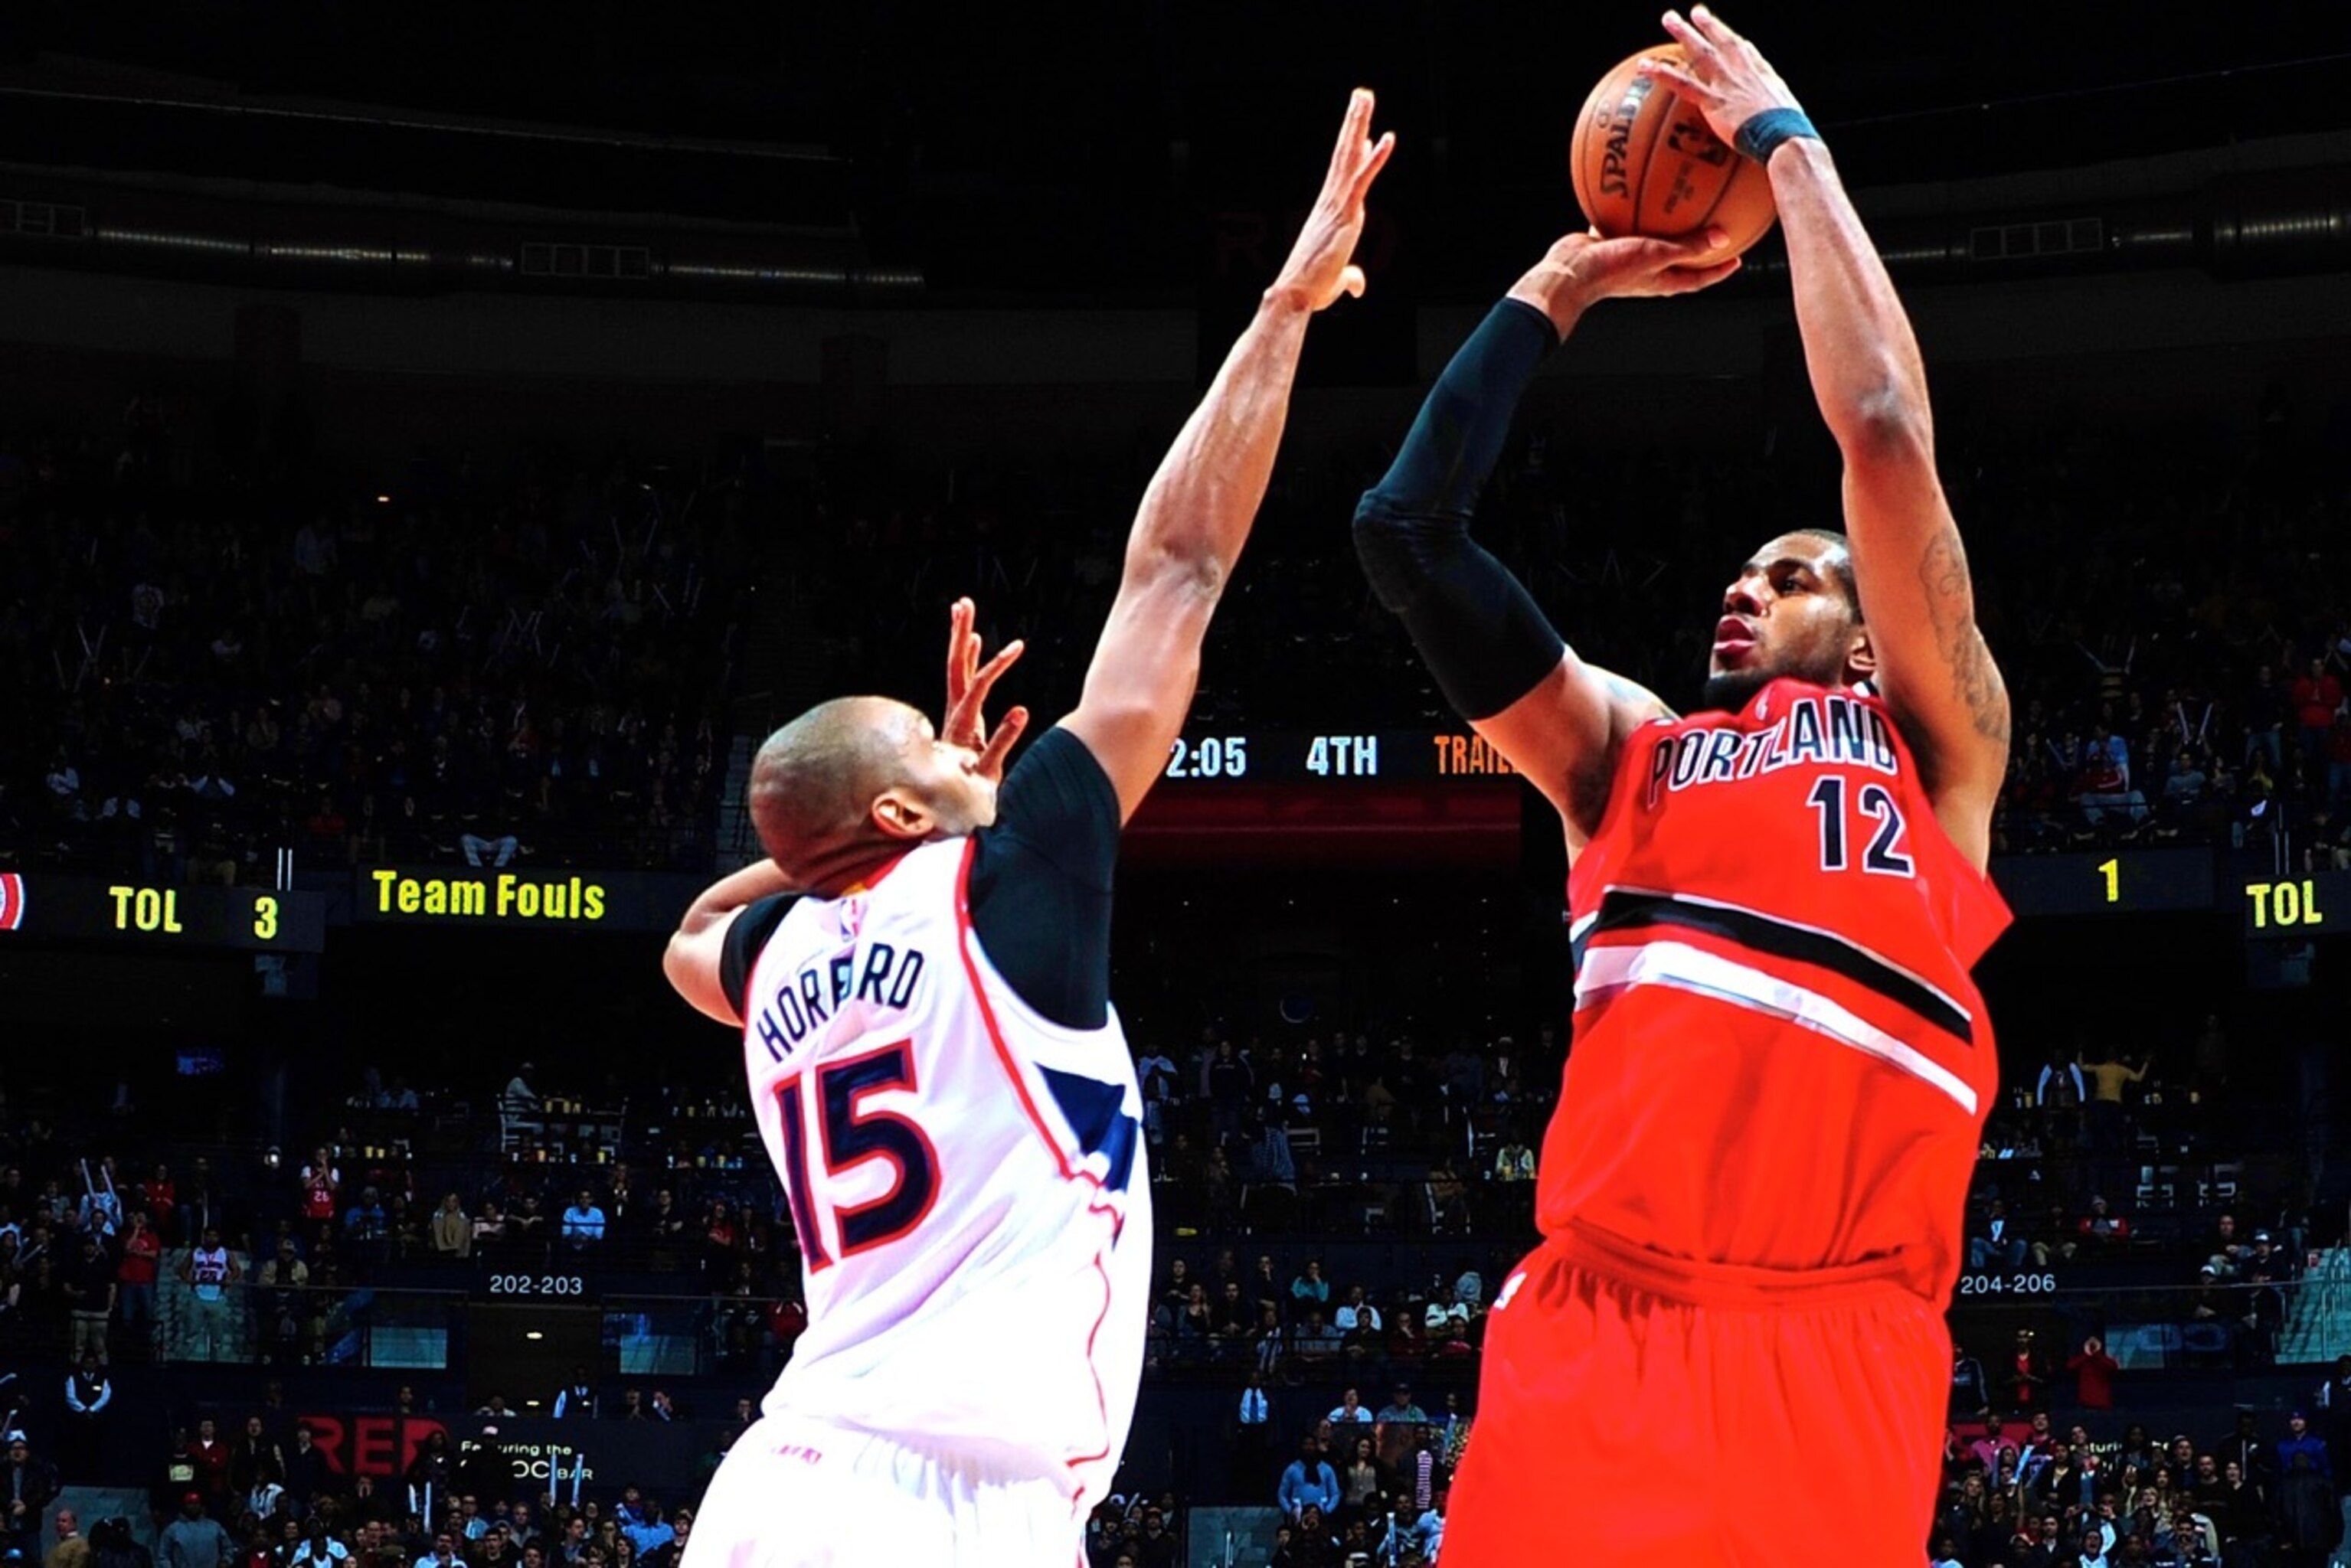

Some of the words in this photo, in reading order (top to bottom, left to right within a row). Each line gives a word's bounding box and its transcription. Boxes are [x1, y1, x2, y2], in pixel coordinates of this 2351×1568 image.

[1306, 735, 1377, 776] 4TH
[1434, 734, 1519, 774] TRAIL
[1648, 697, 1898, 809] PORTLAND
[1807, 775, 1915, 879] 12
[372, 870, 486, 916] Team
[496, 874, 605, 920] Fouls
[2098, 858, 2119, 902] 1
[109, 886, 182, 933] TOL
[254, 897, 278, 939] 3
[2245, 880, 2323, 928] TOL
[771, 1037, 943, 1276] 15
[489, 1274, 584, 1295] 202-203
[1960, 1273, 2056, 1294] 204-206
[461, 1440, 541, 1457] Feuring
[546, 1444, 572, 1455] the
[557, 1467, 594, 1481] BR
